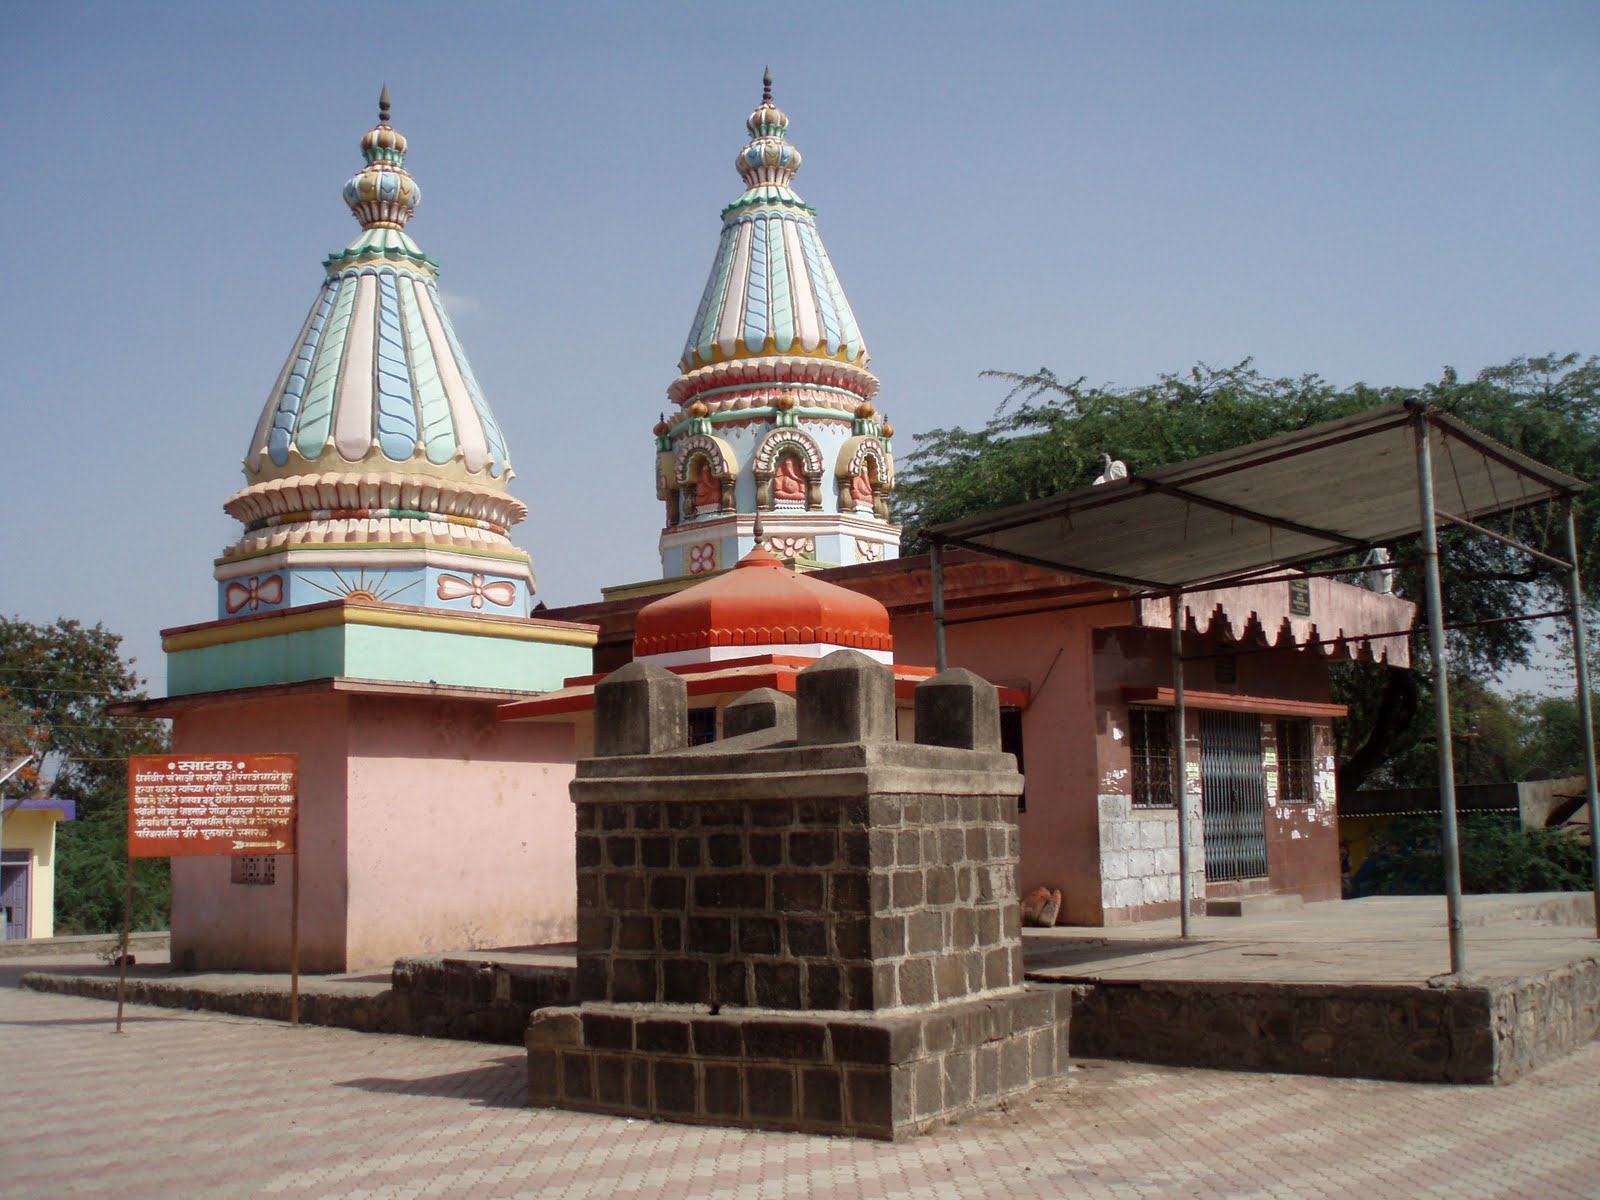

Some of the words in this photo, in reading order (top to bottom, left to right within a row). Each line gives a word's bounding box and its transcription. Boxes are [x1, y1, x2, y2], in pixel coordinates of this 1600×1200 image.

[178, 761, 233, 771] स्मारक
[135, 772, 165, 783] धर्मवीर
[165, 772, 194, 783] संभाजी
[134, 827, 179, 839] परिवारातील
[181, 826, 198, 838] वीर
